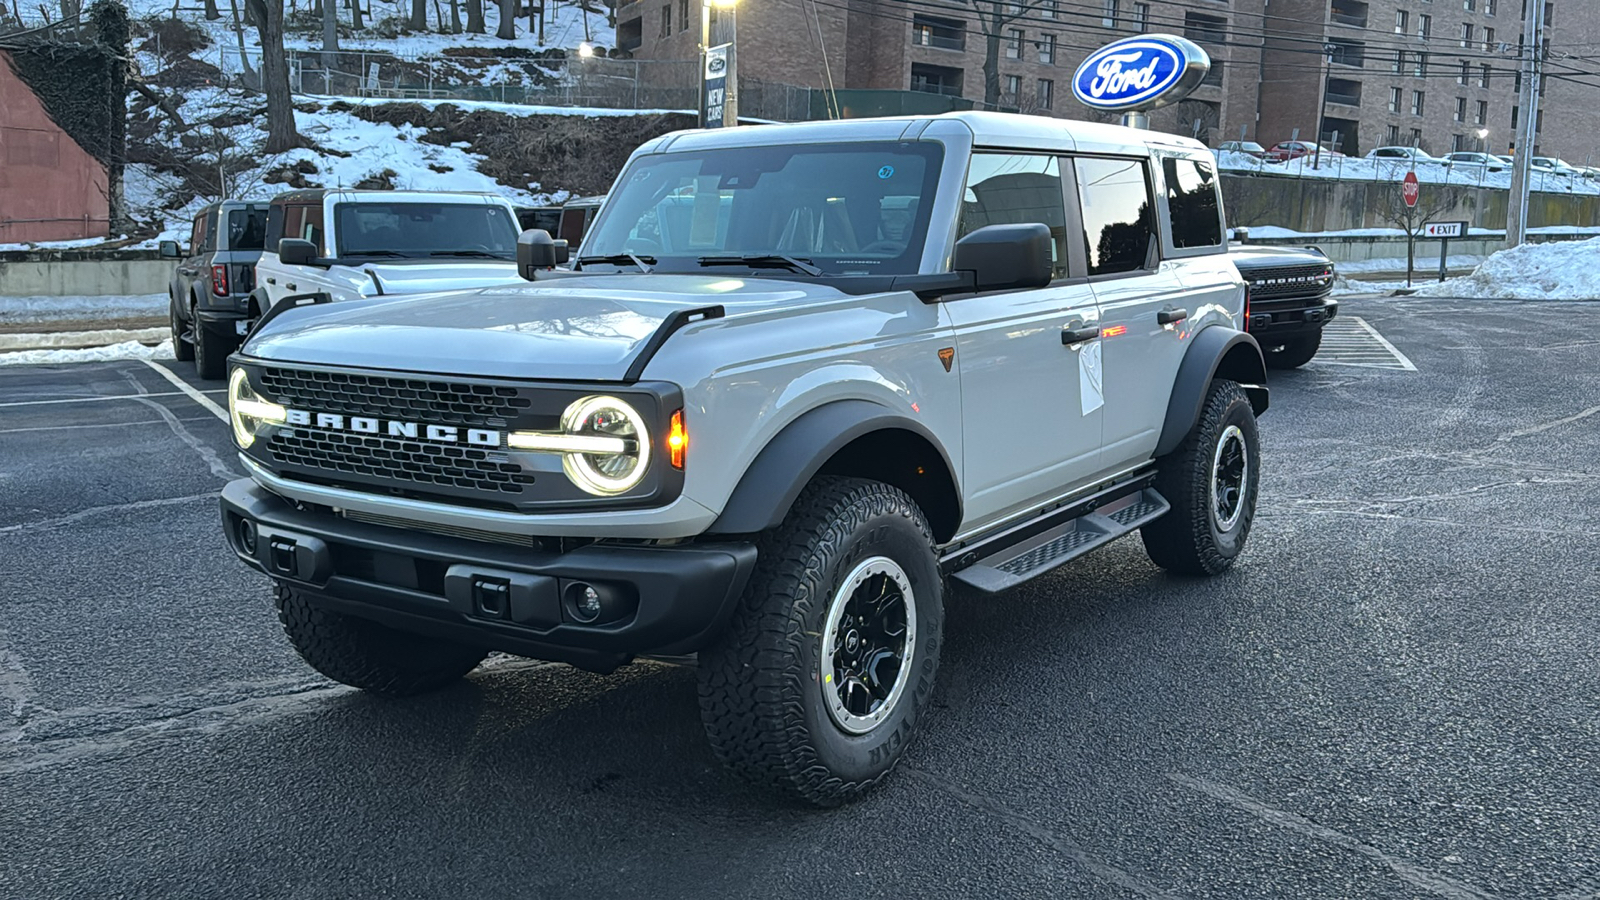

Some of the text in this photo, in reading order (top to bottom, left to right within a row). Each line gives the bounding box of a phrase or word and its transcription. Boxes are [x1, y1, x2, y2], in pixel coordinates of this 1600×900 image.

[1090, 51, 1160, 98] Ford
[708, 88, 724, 106] NEW
[708, 106, 723, 121] CARS
[1404, 182, 1418, 196] STOP
[1437, 225, 1458, 234] EXIT
[1256, 276, 1315, 285] BRONCO
[286, 409, 501, 447] BRONCO
